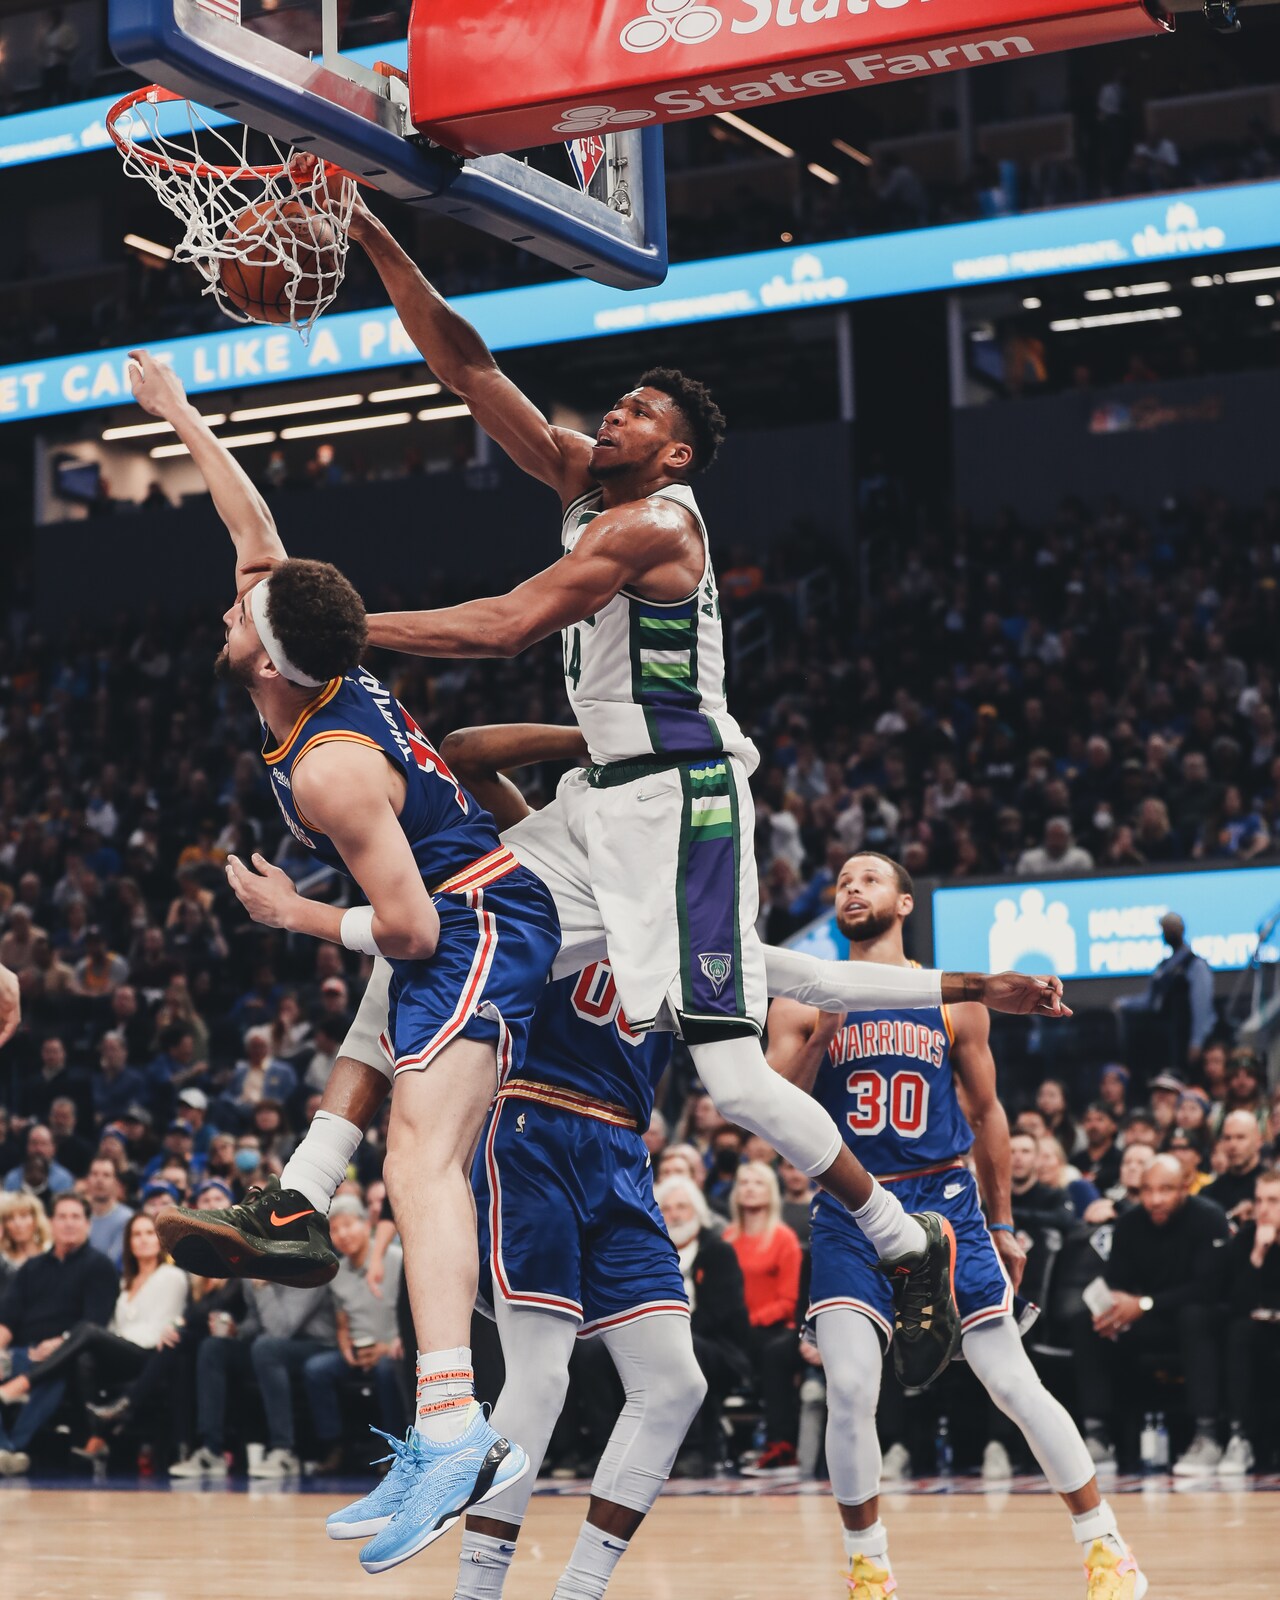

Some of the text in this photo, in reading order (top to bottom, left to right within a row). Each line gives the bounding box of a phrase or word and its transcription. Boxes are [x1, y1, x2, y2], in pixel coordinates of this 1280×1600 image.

[62, 352, 174, 403] CA
[194, 333, 291, 384] LIKE
[308, 329, 342, 367] A
[360, 314, 417, 360] PR
[828, 1020, 946, 1069] WARRIORS
[846, 1069, 930, 1139] 30
